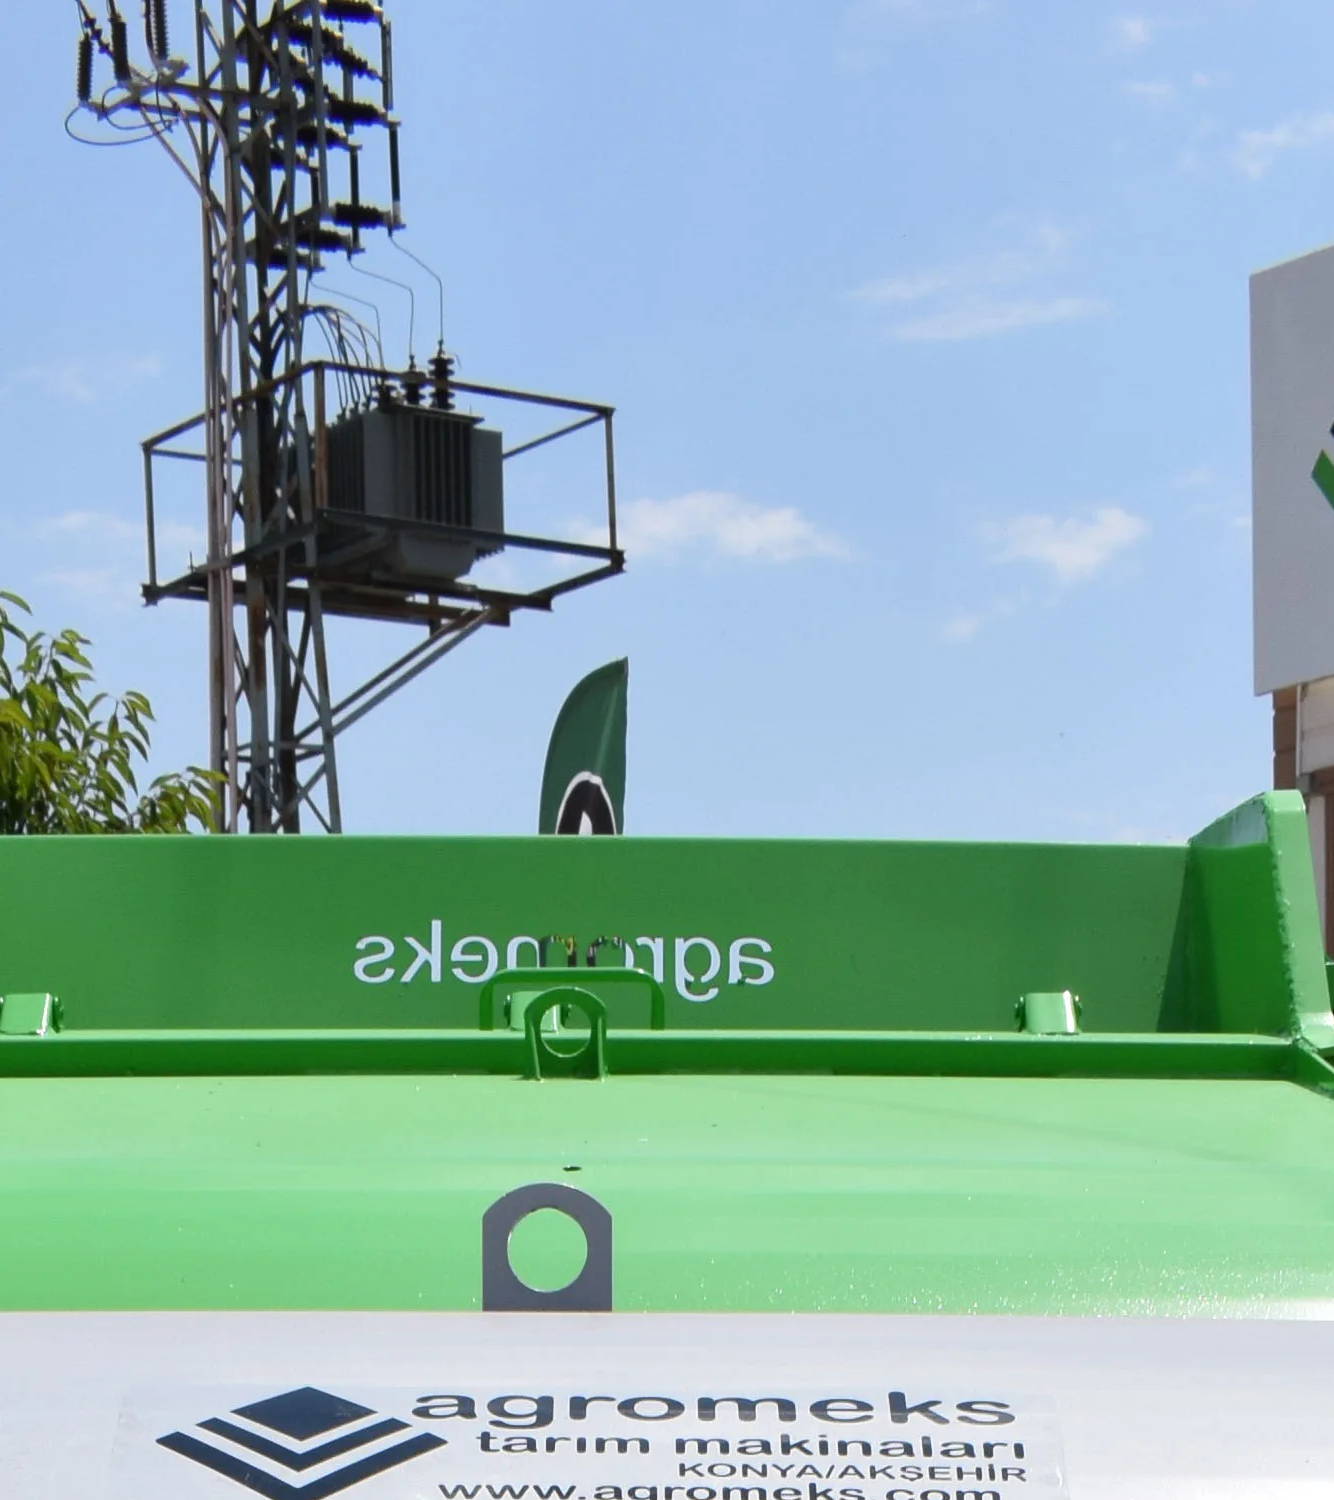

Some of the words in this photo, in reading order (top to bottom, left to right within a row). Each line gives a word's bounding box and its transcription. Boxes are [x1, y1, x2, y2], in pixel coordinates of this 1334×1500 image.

[412, 1391, 1016, 1429] agromeks
[477, 1431, 650, 1455] tarım
[675, 1433, 1026, 1460] makinaları
